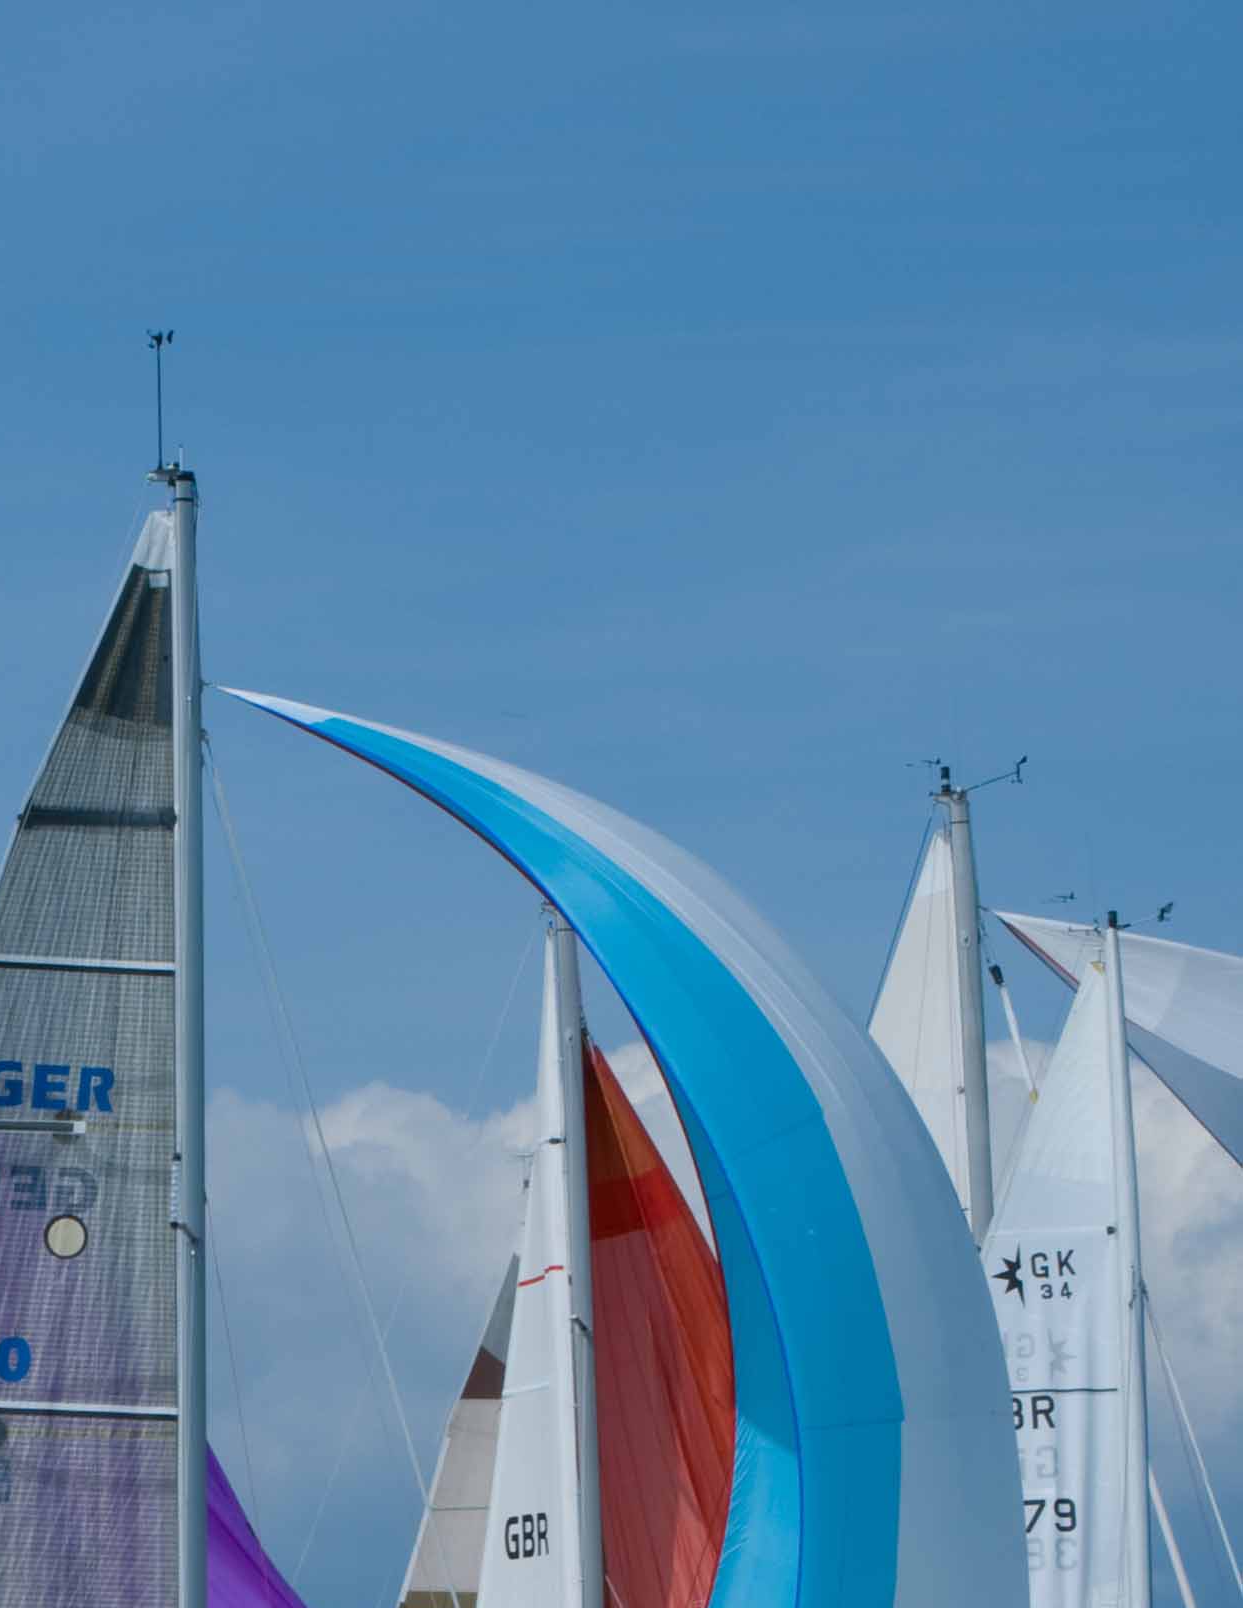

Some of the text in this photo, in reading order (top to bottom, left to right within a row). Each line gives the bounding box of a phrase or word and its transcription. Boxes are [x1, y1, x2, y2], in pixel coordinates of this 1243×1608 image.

[1030, 1249, 1076, 1278] GK
[1040, 1282, 1073, 1300] 34
[1023, 1498, 1078, 1534] 79
[504, 1512, 550, 1560] GBR
